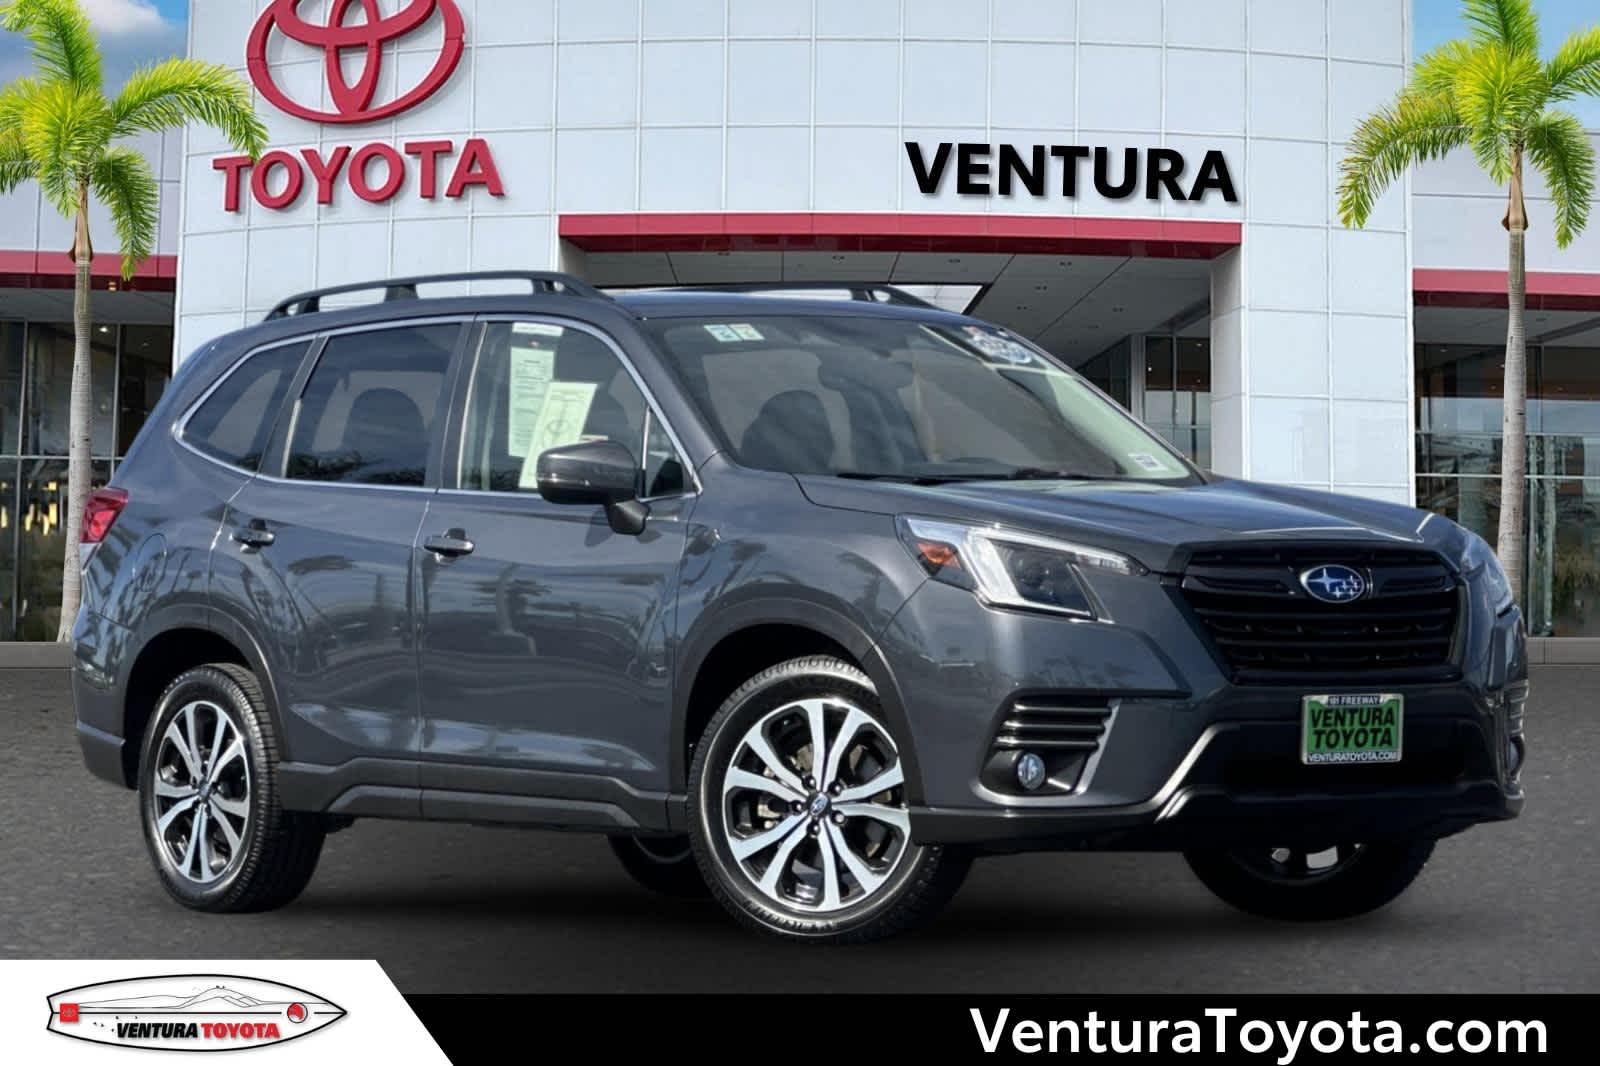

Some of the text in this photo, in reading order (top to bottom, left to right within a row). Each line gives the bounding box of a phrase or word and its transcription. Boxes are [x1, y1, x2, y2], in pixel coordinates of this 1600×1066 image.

[213, 138, 505, 212] TOYOTA
[905, 141, 1239, 203] VENTURA
[1341, 695, 1379, 705] FREEWAY
[1310, 707, 1395, 728] VENTURA
[1313, 727, 1393, 749] TOYOTA
